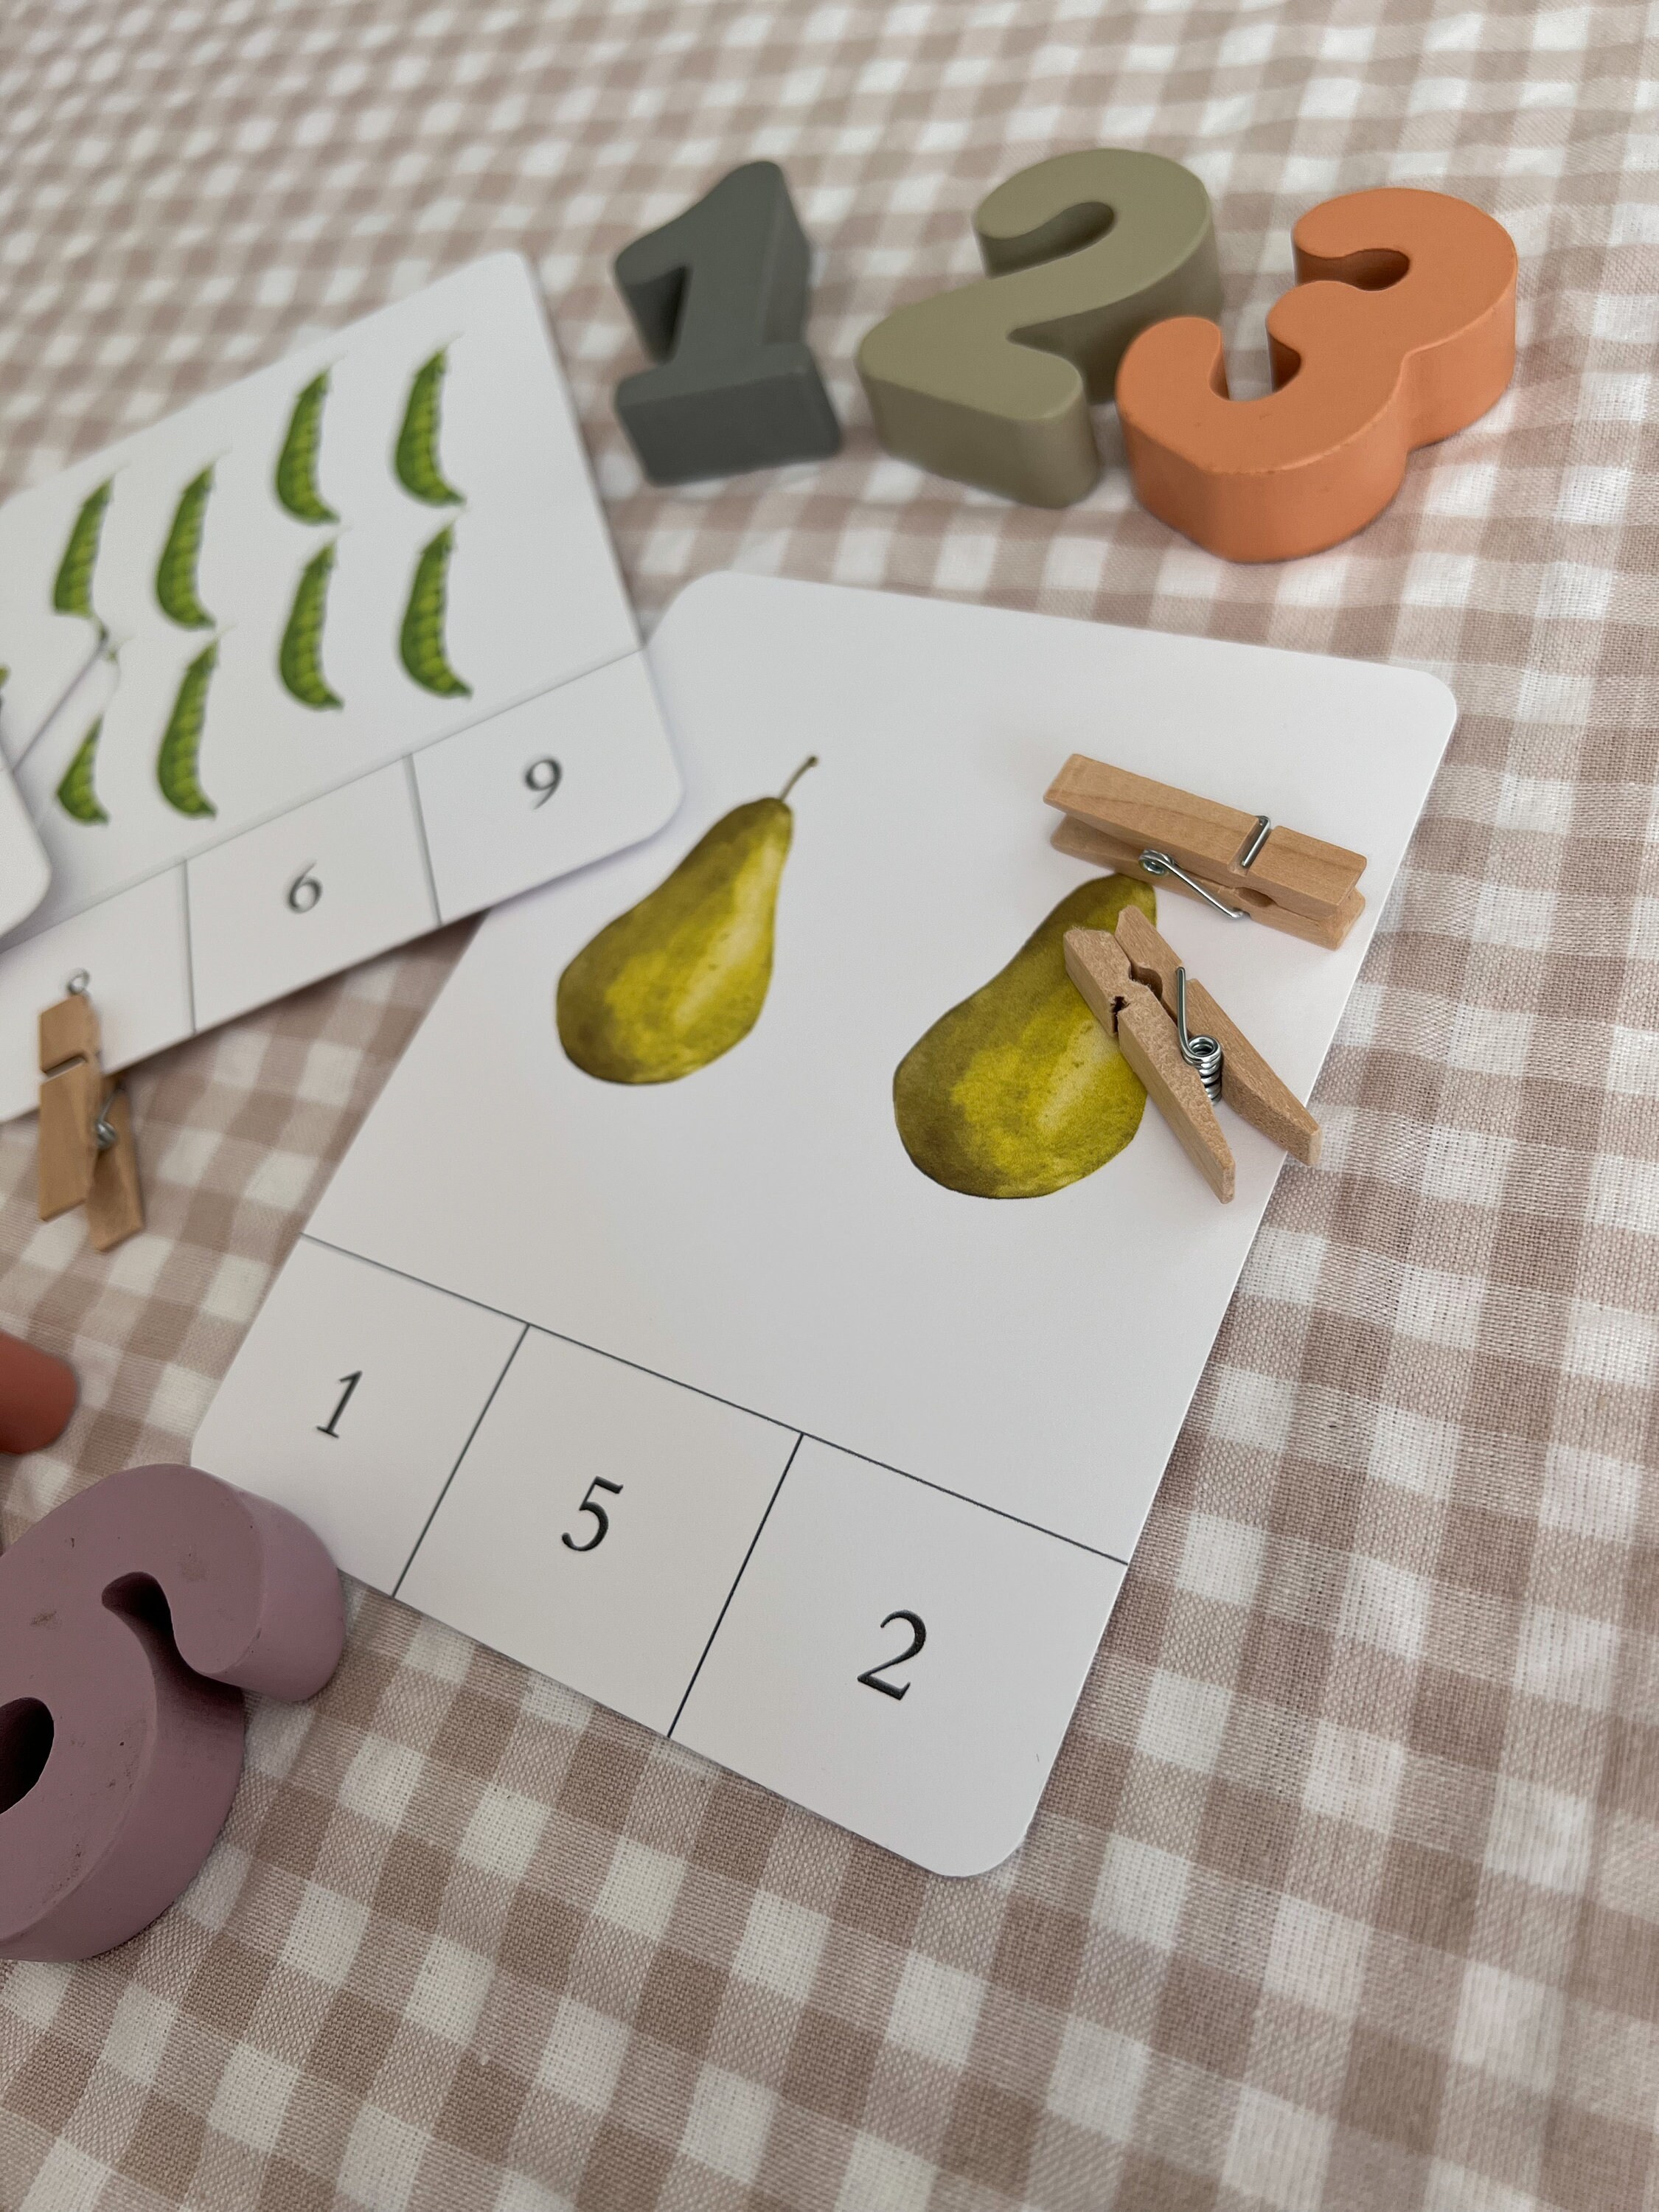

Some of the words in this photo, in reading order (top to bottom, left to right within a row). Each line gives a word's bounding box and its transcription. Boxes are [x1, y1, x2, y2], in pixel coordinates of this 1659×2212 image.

[613, 160, 842, 485] 1
[858, 147, 1221, 509] 2
[1116, 187, 1517, 563] 3
[285, 863, 323, 914] 6
[522, 755, 563, 810] 9
[316, 1370, 363, 1439] 1
[560, 1475, 624, 1553] 5
[857, 1610, 928, 1701] 2
